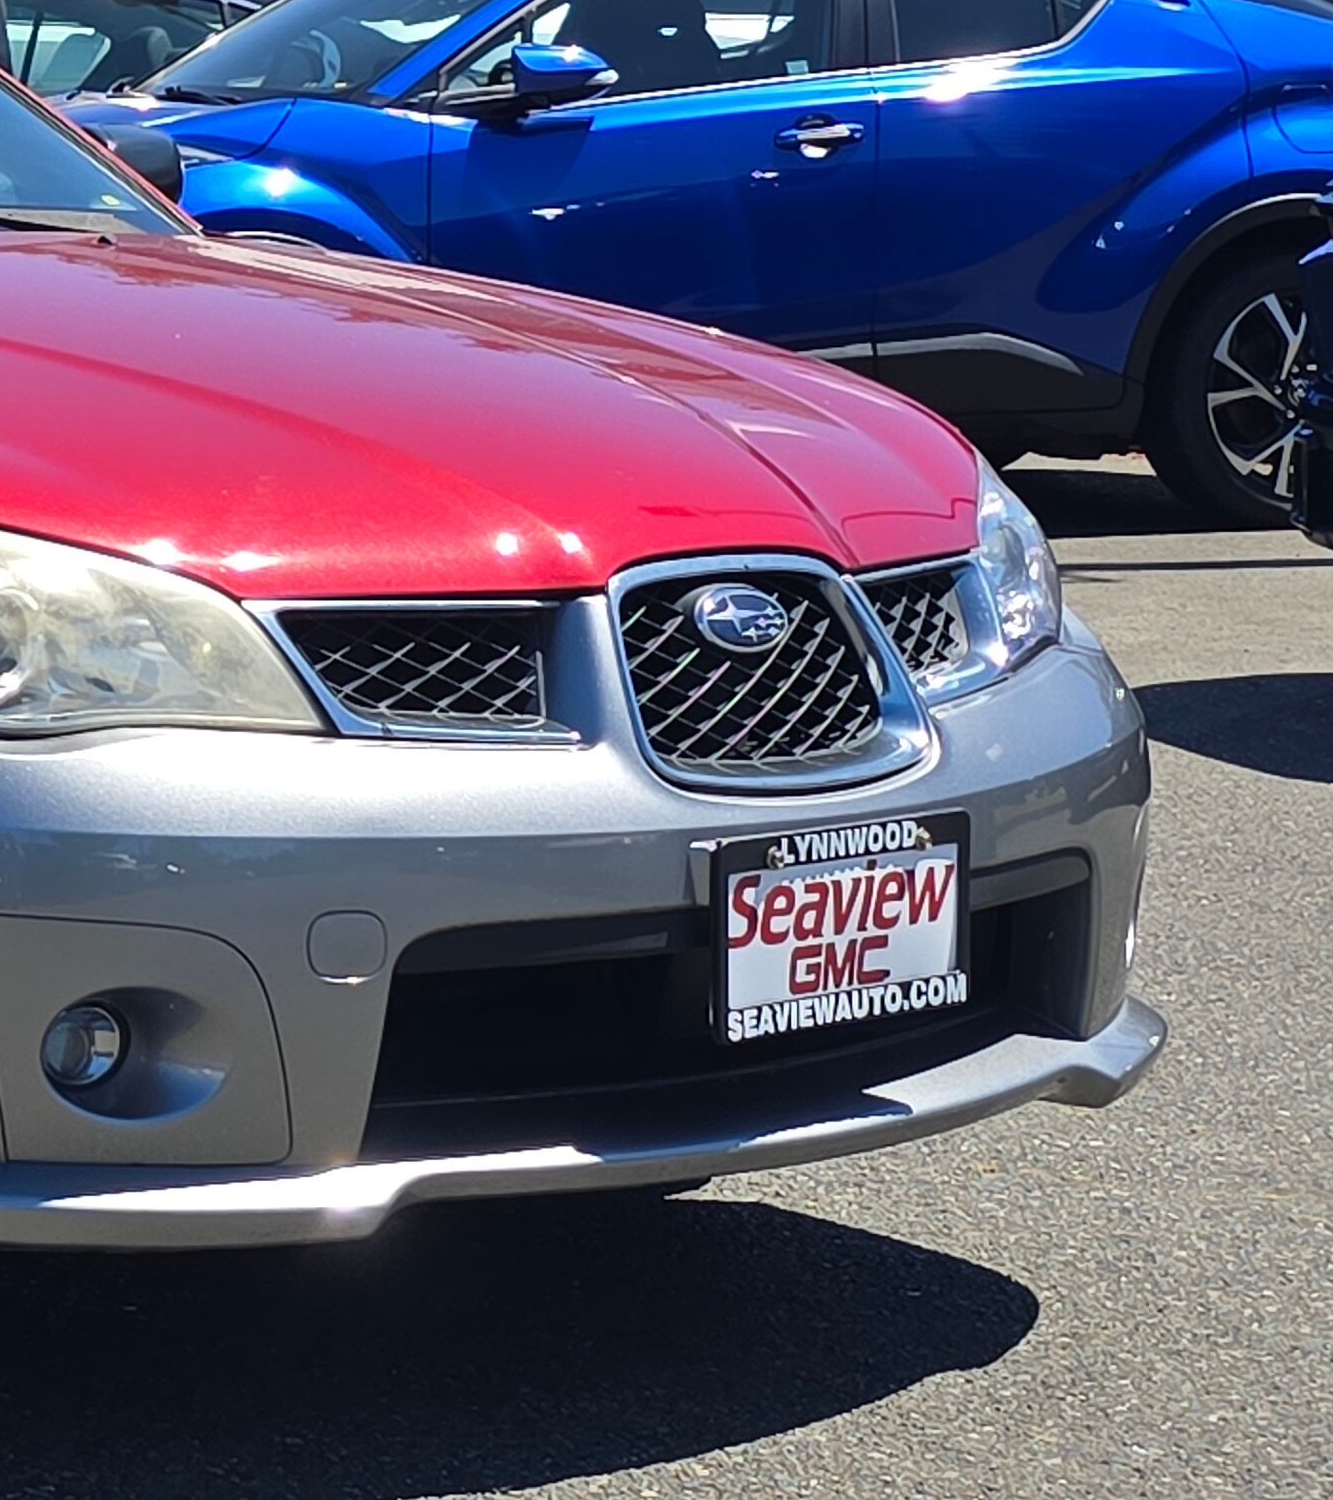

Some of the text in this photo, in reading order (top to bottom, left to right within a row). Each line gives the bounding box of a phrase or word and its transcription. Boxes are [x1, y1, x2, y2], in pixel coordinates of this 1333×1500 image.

[780, 820, 918, 865] LYNNWOOD
[727, 859, 955, 949] Seaview
[789, 935, 890, 996] GMC
[727, 972, 967, 1042] SEAVIEWAUTO.COM
